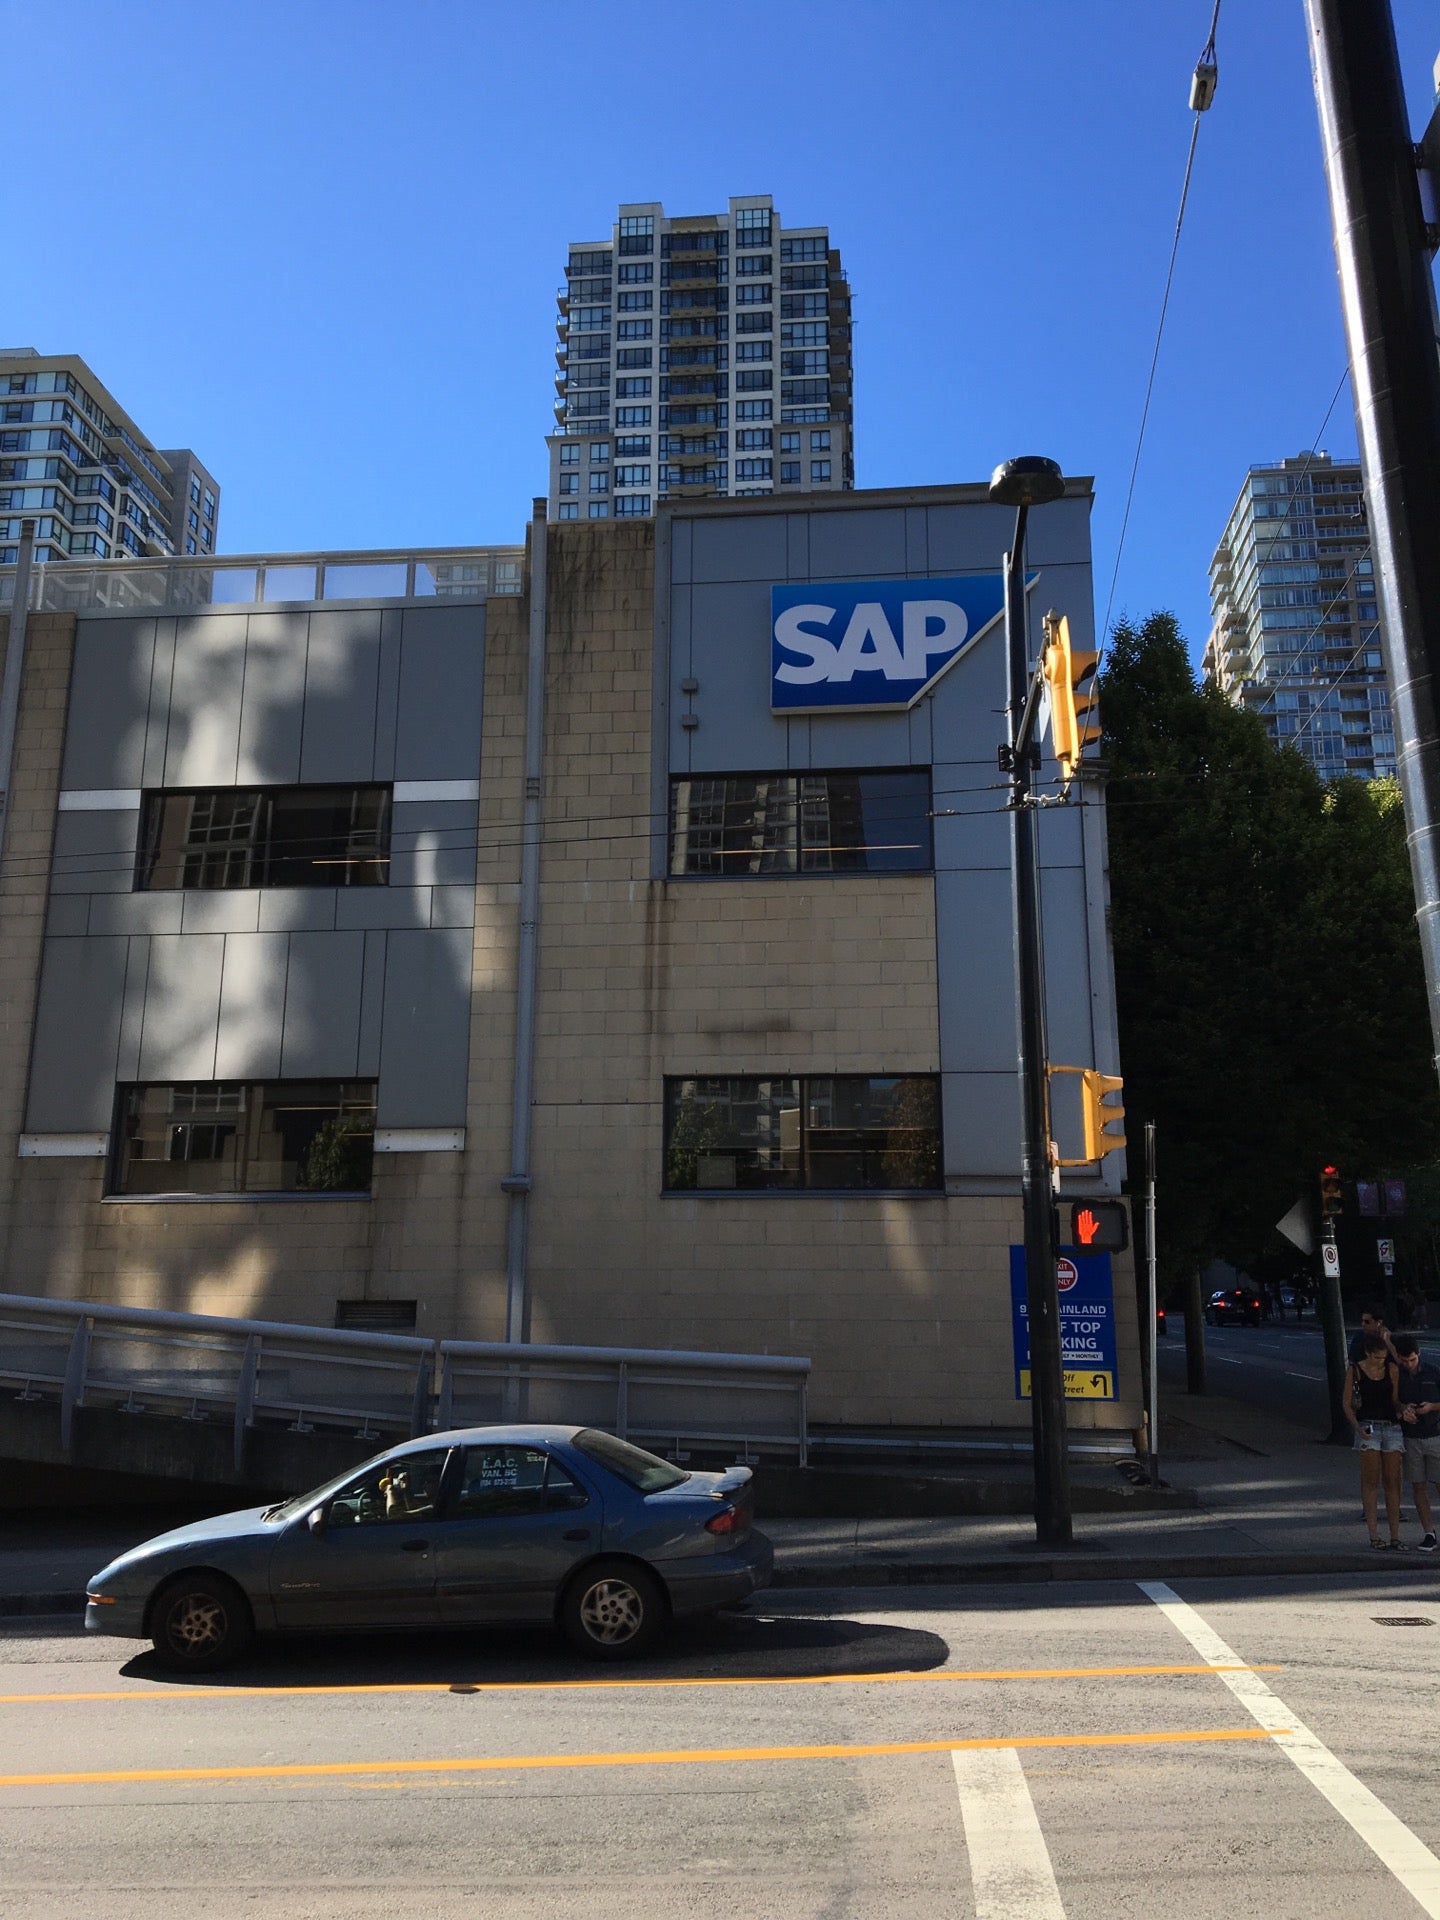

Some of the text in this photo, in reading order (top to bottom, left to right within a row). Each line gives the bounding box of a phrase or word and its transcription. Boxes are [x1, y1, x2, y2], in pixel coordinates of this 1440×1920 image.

[774, 600, 968, 685] SAP
[1060, 1305, 1107, 1315] INLAND
[1071, 1321, 1101, 1334] TOP
[1061, 1336, 1097, 1350] KING
[1063, 1386, 1084, 1394] treet
